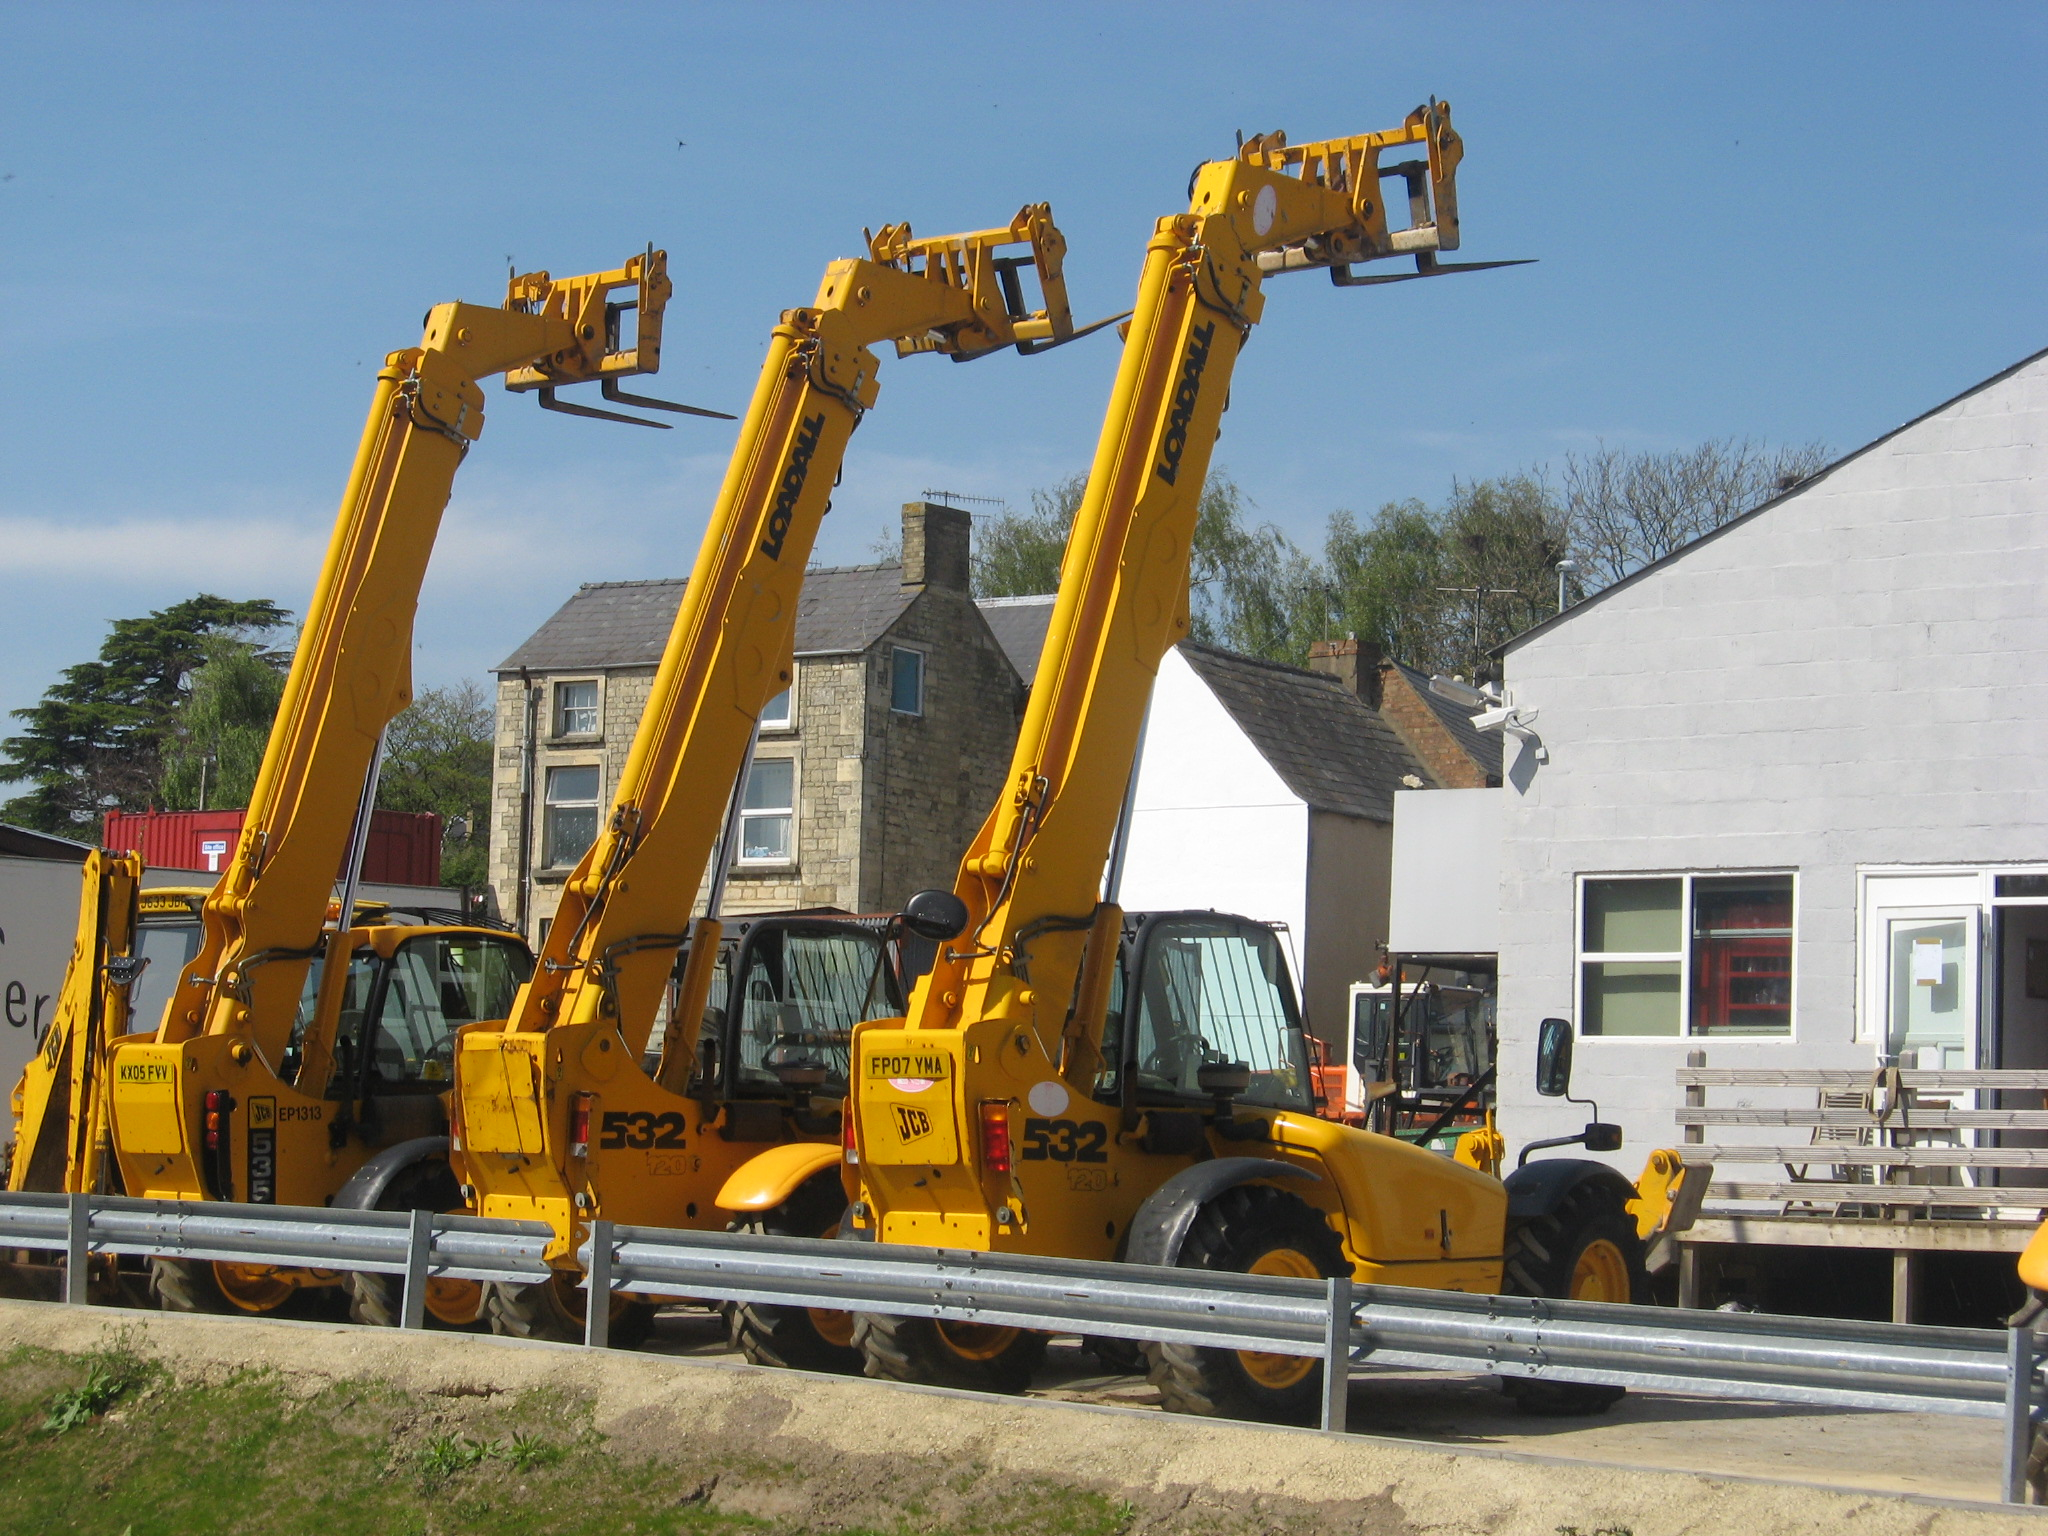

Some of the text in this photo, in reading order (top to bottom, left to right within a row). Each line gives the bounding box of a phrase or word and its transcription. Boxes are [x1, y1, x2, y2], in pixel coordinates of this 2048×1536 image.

[1156, 320, 1215, 487] LOADALL
[760, 412, 826, 562] LOADALL
[120, 1065, 146, 1080] KX05
[872, 1057, 943, 1074] FP07 YMA
[254, 1104, 272, 1122] JCB
[279, 1106, 322, 1121] EP1313
[600, 1112, 686, 1149] 532
[897, 1107, 930, 1141] JCB
[1022, 1118, 1107, 1163] 532
[252, 1132, 272, 1203] 535
